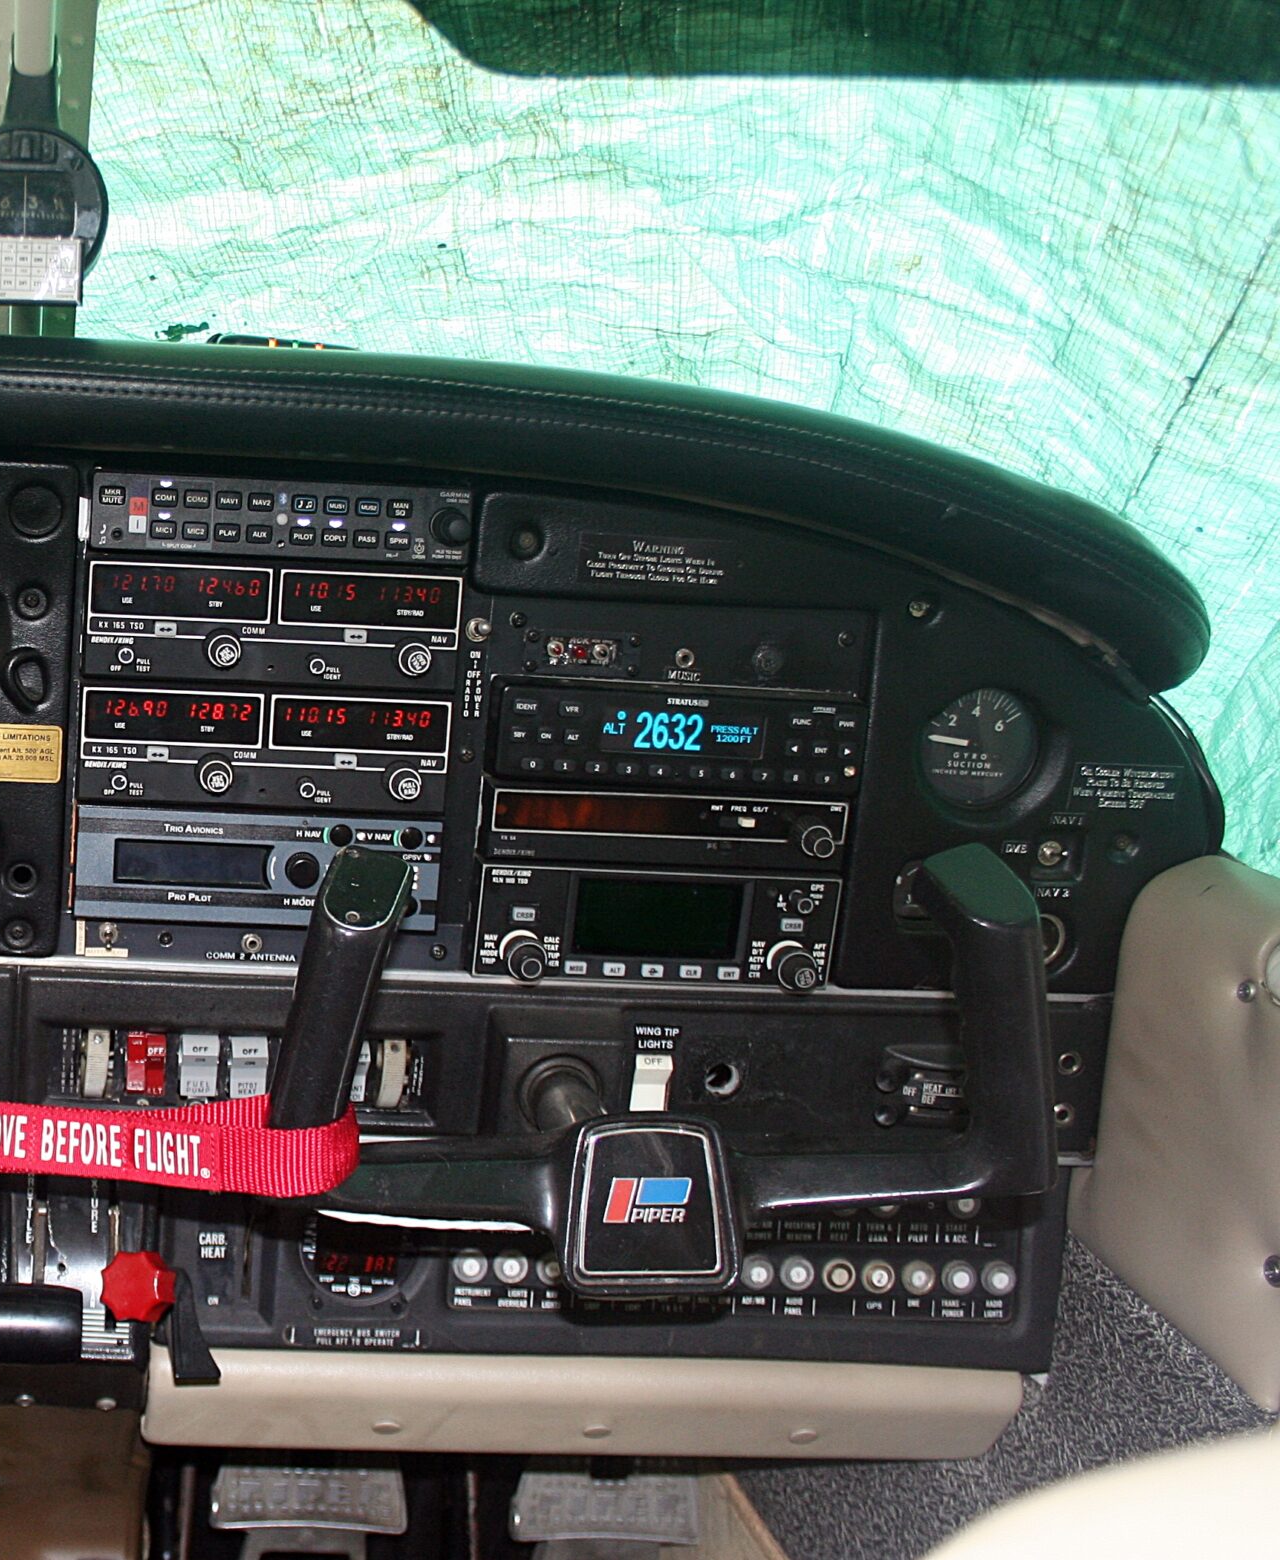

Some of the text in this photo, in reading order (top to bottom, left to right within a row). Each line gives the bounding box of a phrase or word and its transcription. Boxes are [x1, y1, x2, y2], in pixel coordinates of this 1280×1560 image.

[155, 494, 176, 502] COM1
[186, 495, 208, 504] COM2
[220, 497, 239, 505] NAV1
[252, 499, 271, 507] NAV2
[218, 529, 237, 537] PLAY
[293, 532, 313, 541] PILOT
[324, 534, 346, 542] COPLT
[358, 536, 376, 544] PASS
[98, 620, 109, 629] KX
[130, 622, 145, 630] TSO
[242, 626, 266, 635] COMM
[91, 636, 134, 645] BENDIX/KING
[431, 636, 448, 644] NAV
[467, 671, 481, 679] OFF
[668, 670, 701, 682] MUSIC
[667, 698, 698, 707] STRATUS
[792, 718, 813, 726] FUNC
[838, 720, 855, 728] PWR
[603, 711, 704, 751] ALT 2632
[710, 725, 759, 736] PRESS ALT
[2, 733, 51, 742] LIMITATIONS
[540, 732, 552, 740] ON
[716, 734, 740, 744] 1200
[234, 751, 257, 760] COMM
[953, 752, 987, 760] GYRO
[84, 761, 128, 769] BENDIX/KING
[948, 760, 991, 769] SUCTION
[164, 824, 224, 835] TRIO AVIONICS
[304, 830, 322, 838] NAV
[374, 833, 392, 841] NAV
[168, 892, 212, 902] PRO PILOT
[484, 934, 498, 942] NAV
[544, 936, 560, 944] CALC
[206, 952, 296, 962] COMM ANTENNA
[636, 1026, 680, 1037] WING TIP
[638, 1040, 674, 1050] LIGHTS
[148, 1046, 165, 1056] OFF
[644, 1057, 663, 1066] OFF
[922, 1082, 943, 1094] HEAT
[40, 1118, 123, 1168] BEFORE
[631, 1208, 686, 1224] PIPER
[199, 1232, 228, 1246] CARB.
[908, 1234, 929, 1243] PILOT
[201, 1246, 226, 1259] HEAT
[454, 1288, 492, 1297] INSTRUMENT
[207, 1296, 219, 1306] ON
[498, 1299, 528, 1309] OVERHEAD
[986, 1300, 1003, 1309] RADIO
[784, 1306, 802, 1316] PANEL
[866, 1302, 883, 1311] GPS
[984, 1309, 1004, 1318] LIGHTS
[314, 1328, 400, 1338] EMERGENCY BUS SWITCH
[364, 1338, 394, 1347] OPERATE
